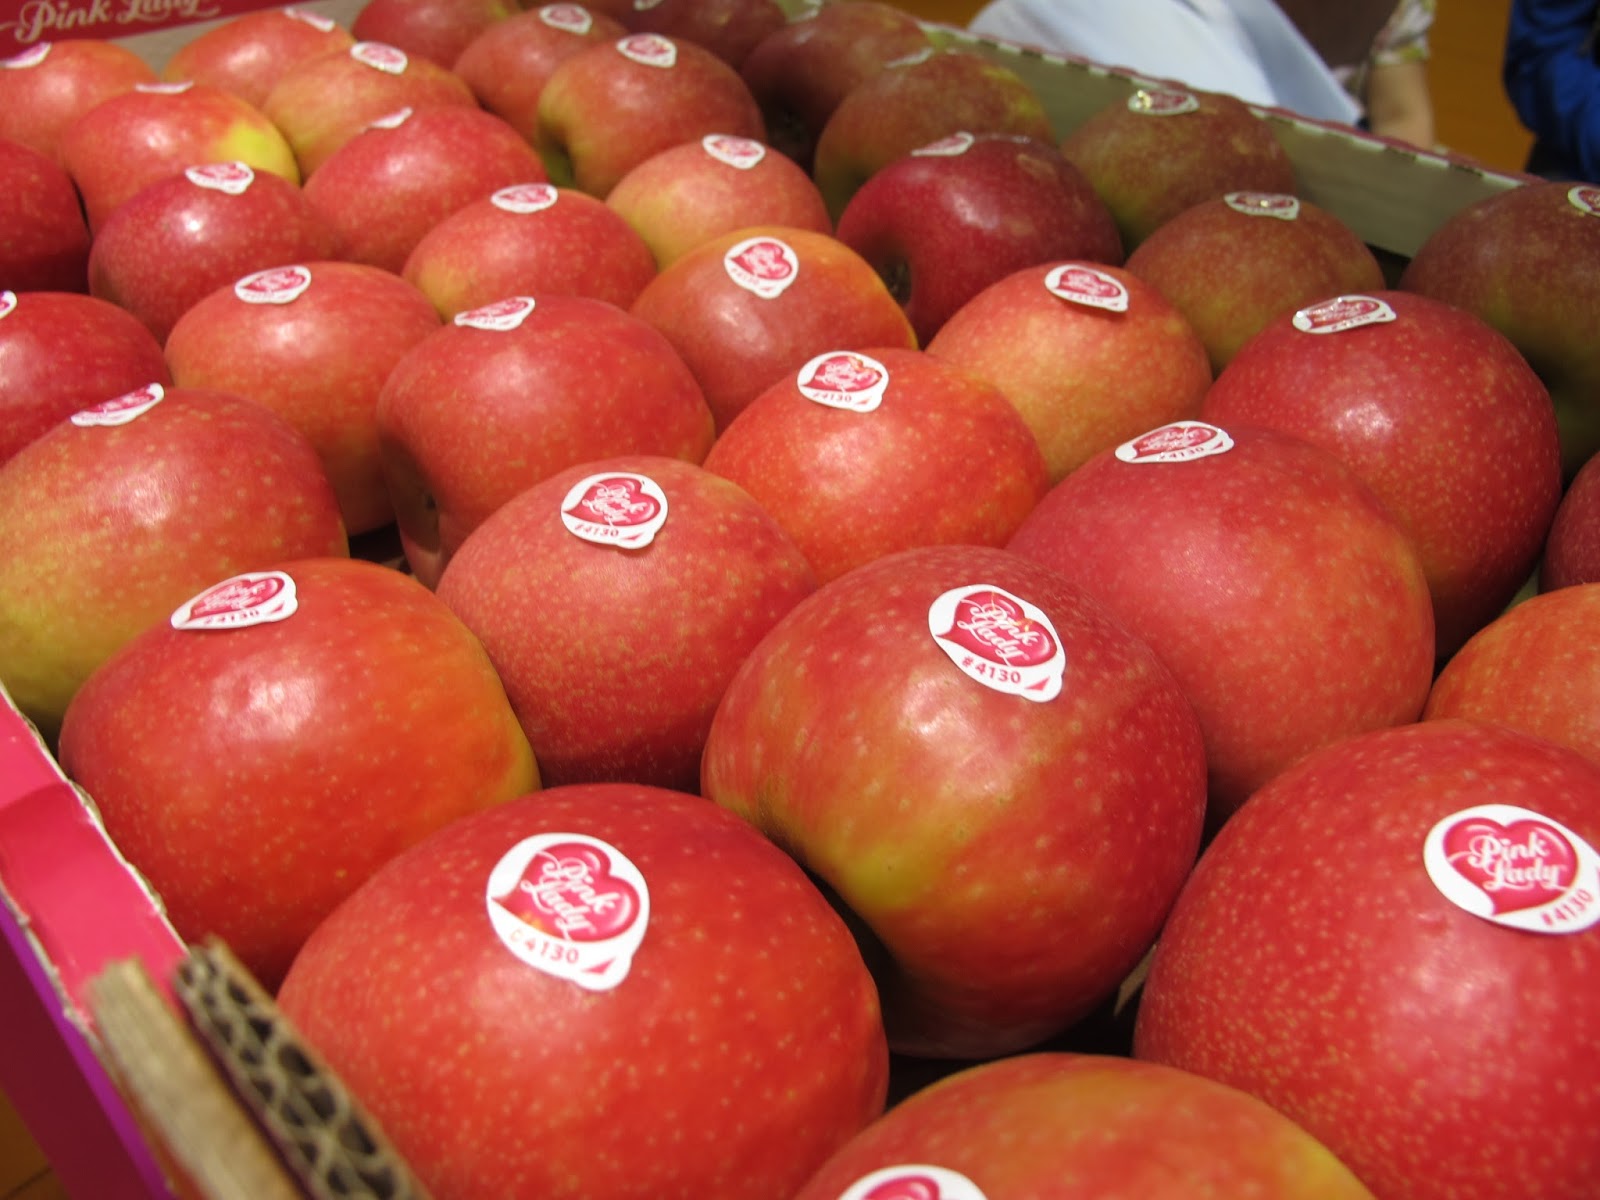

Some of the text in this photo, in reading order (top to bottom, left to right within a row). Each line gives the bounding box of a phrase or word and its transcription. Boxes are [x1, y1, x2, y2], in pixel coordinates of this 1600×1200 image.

[0, 0, 112, 43] Pink
[956, 619, 1031, 668] Lady
[959, 599, 1041, 647] Pink
[960, 654, 1022, 684] #4130
[1448, 827, 1549, 869] Pink
[537, 851, 621, 916] Pink
[1482, 856, 1569, 892] Lady
[520, 876, 598, 942] Lady
